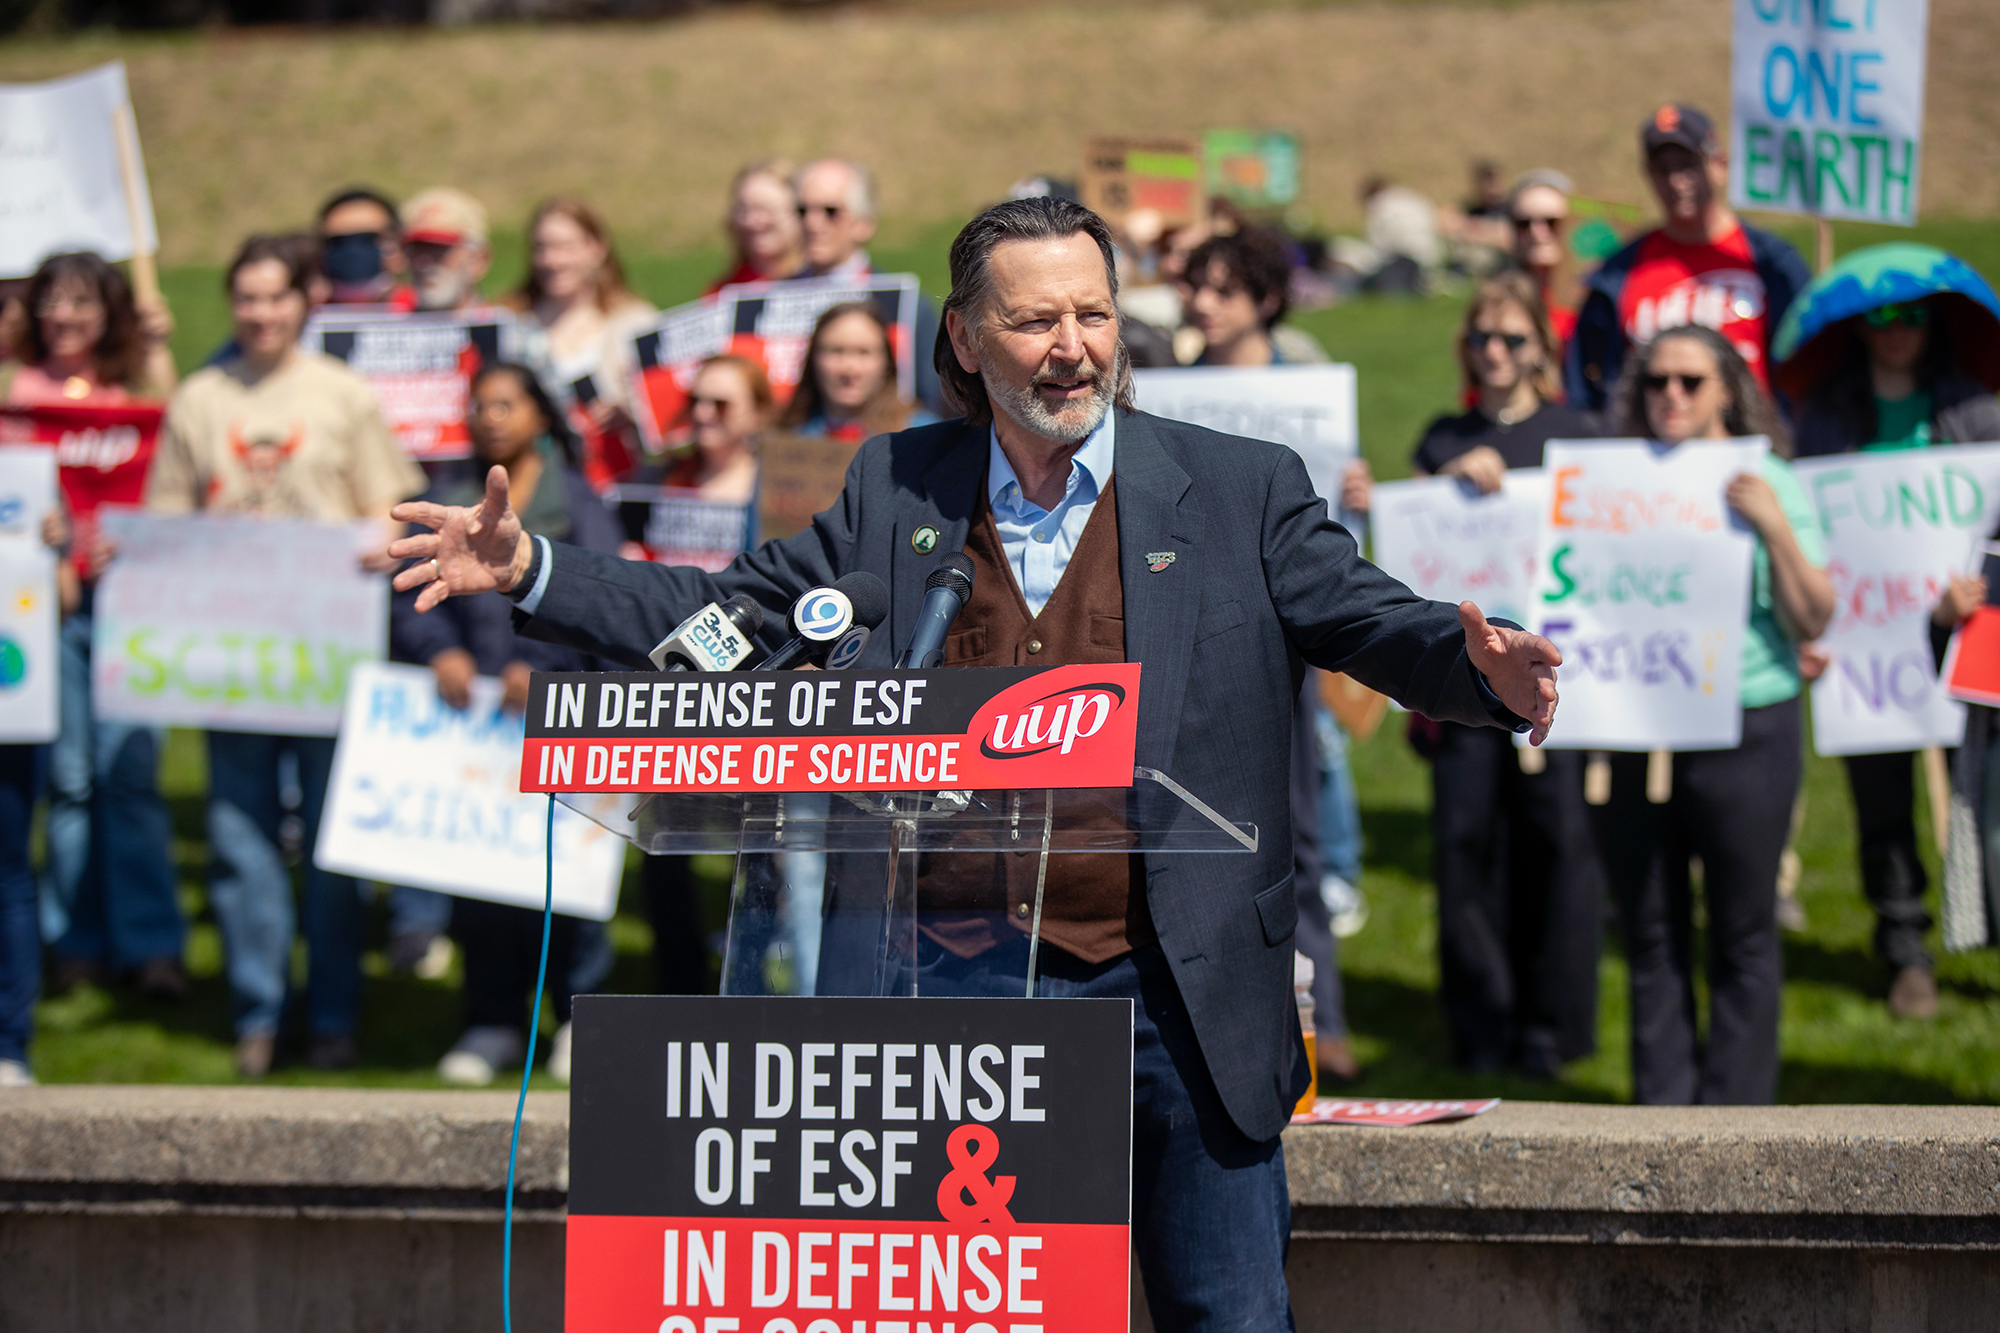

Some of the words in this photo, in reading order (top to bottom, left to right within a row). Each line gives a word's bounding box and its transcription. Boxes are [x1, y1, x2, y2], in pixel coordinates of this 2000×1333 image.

[1762, 44, 1884, 126] ONE
[1745, 126, 1914, 216] EARTH
[1812, 463, 1985, 538] FUND
[125, 626, 370, 705] SCIEN
[545, 683, 586, 728] IN
[598, 682, 775, 728] DEFENSE
[788, 681, 841, 727] OF
[853, 680, 927, 725] ESF
[538, 745, 575, 785] IN
[586, 745, 742, 785] DEFENSE
[753, 744, 798, 784] OF
[808, 742, 960, 784] SCIENCE
[992, 694, 1111, 755] uup
[666, 1042, 729, 1118] IN
[755, 1043, 1046, 1122] DEFENSE
[695, 1128, 777, 1205] OF
[801, 1130, 918, 1207] ESF
[937, 1123, 1017, 1224] &
[664, 1230, 726, 1307] IN
[752, 1232, 1043, 1313] DEFENSE
